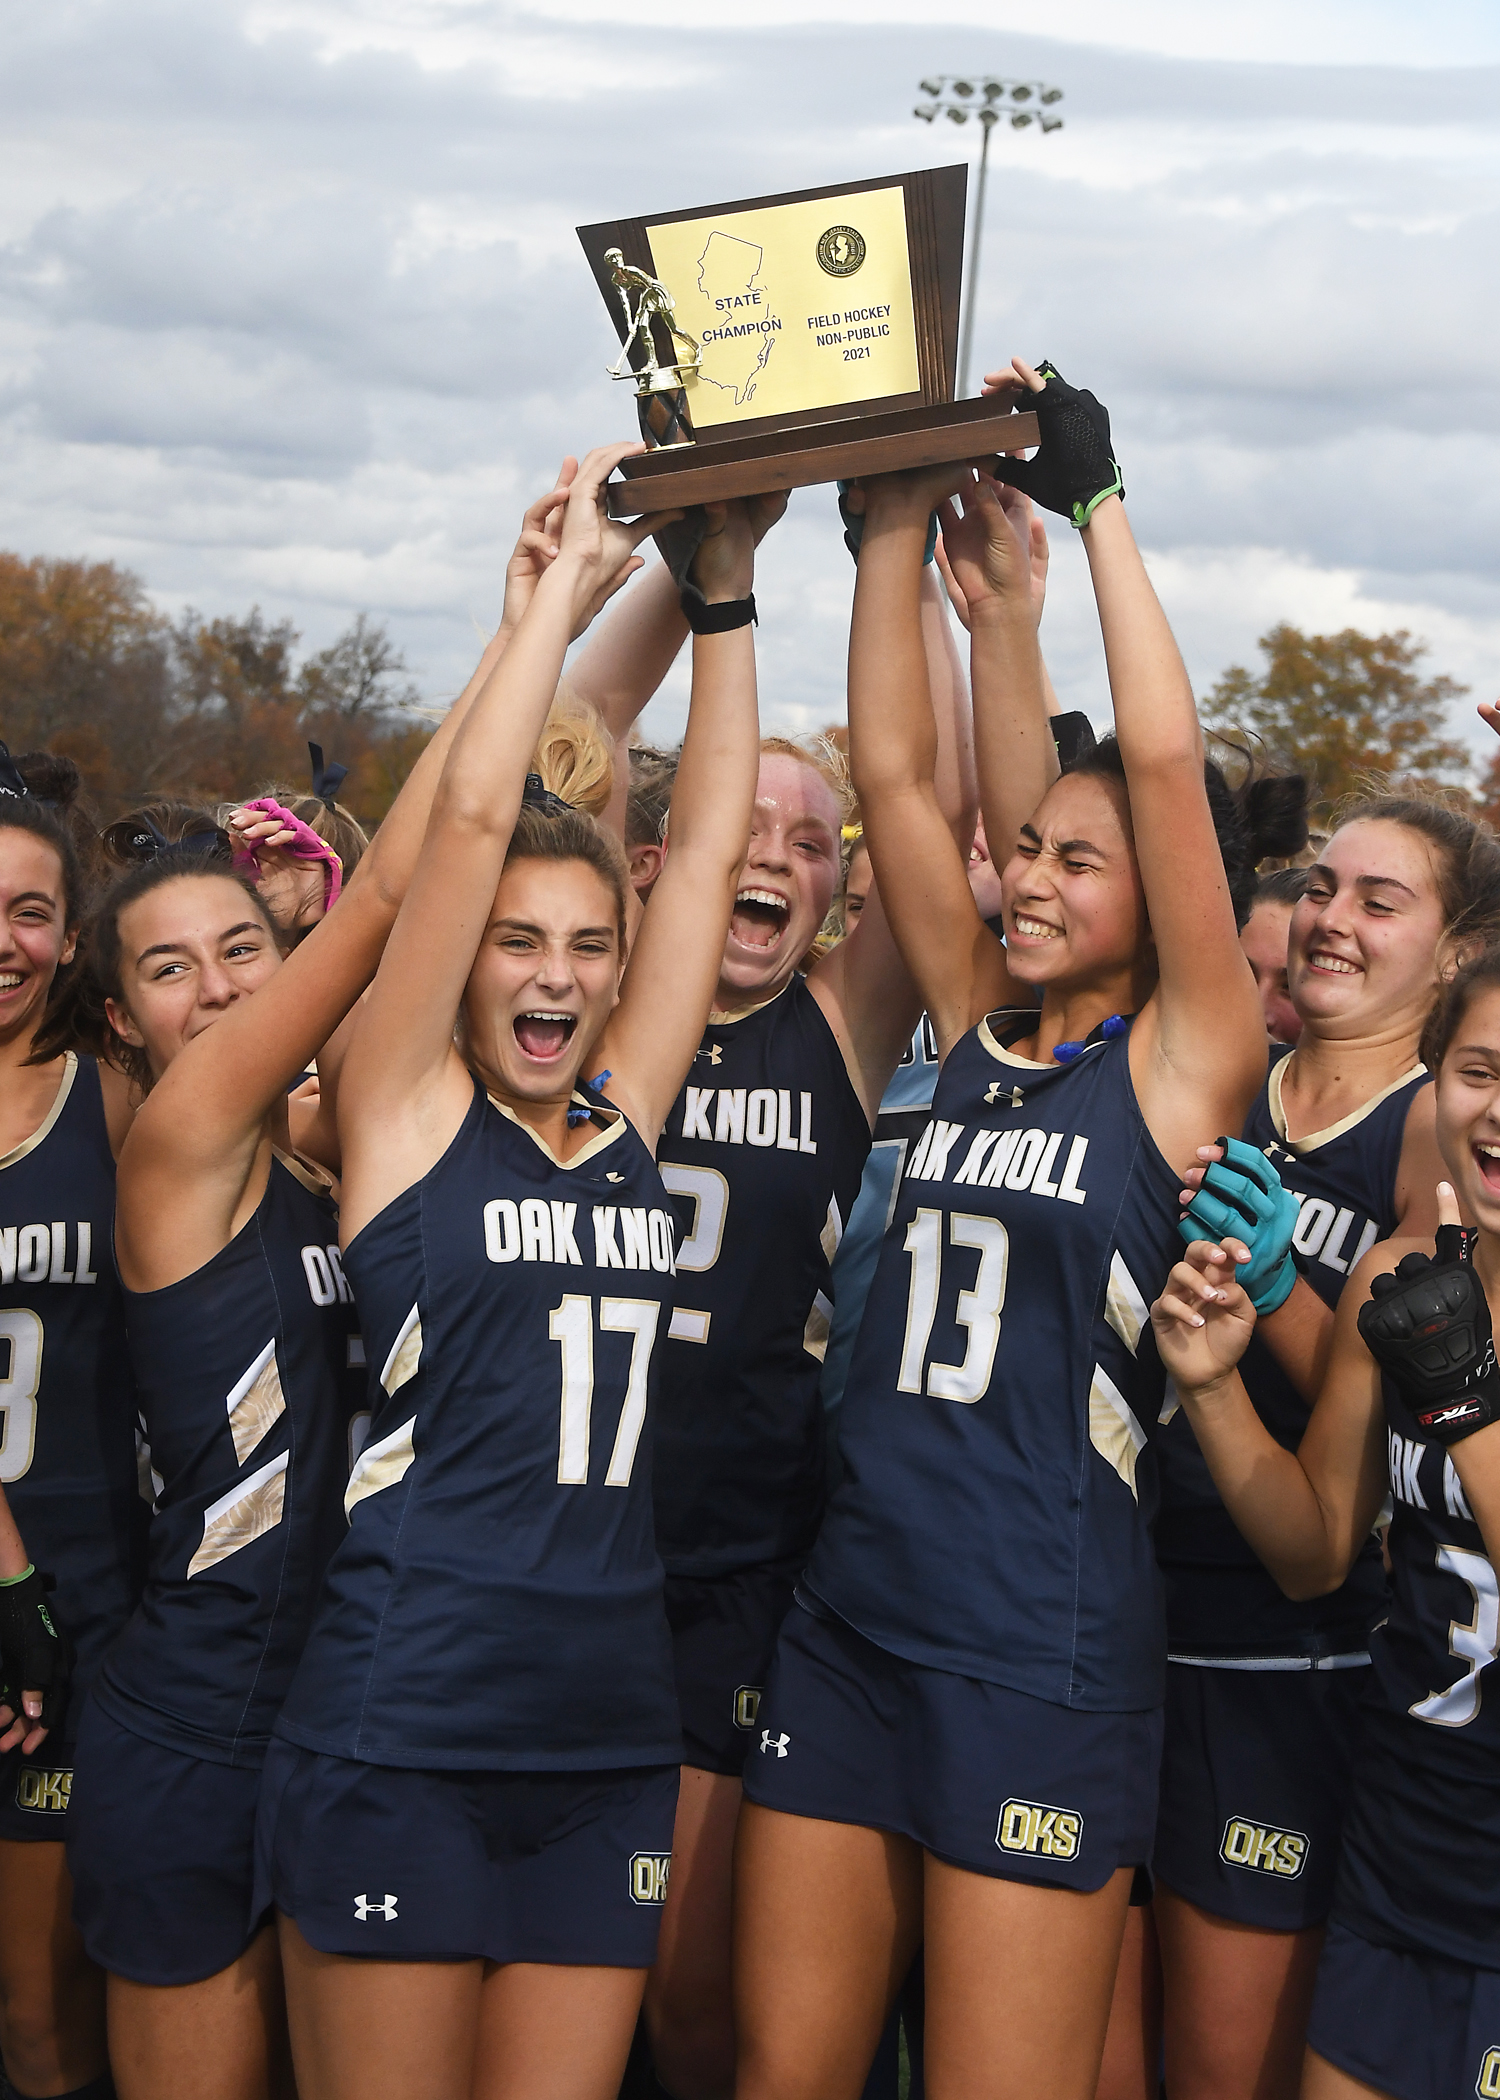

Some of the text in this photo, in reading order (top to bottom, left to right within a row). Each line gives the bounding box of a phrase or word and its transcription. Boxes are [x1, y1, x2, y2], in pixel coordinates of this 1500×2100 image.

[715, 292, 762, 311] STATE
[807, 304, 891, 329] FIELD HOCKEY
[702, 318, 782, 342] CHAMPION
[816, 324, 890, 347] NON-PUBLIC
[842, 346, 871, 362] 2021
[682, 1085, 818, 1155] KNOLL
[952, 1128, 1090, 1205] KNOLL
[483, 1198, 584, 1267] OAK
[896, 1206, 1010, 1404] 13
[548, 1293, 662, 1487] 17
[1387, 1424, 1431, 1512] AK
[1407, 1541, 1500, 1728] 3
[1000, 1803, 1080, 1857] OKS
[1223, 1820, 1306, 1875] OKS
[633, 1857, 671, 1900] OK
